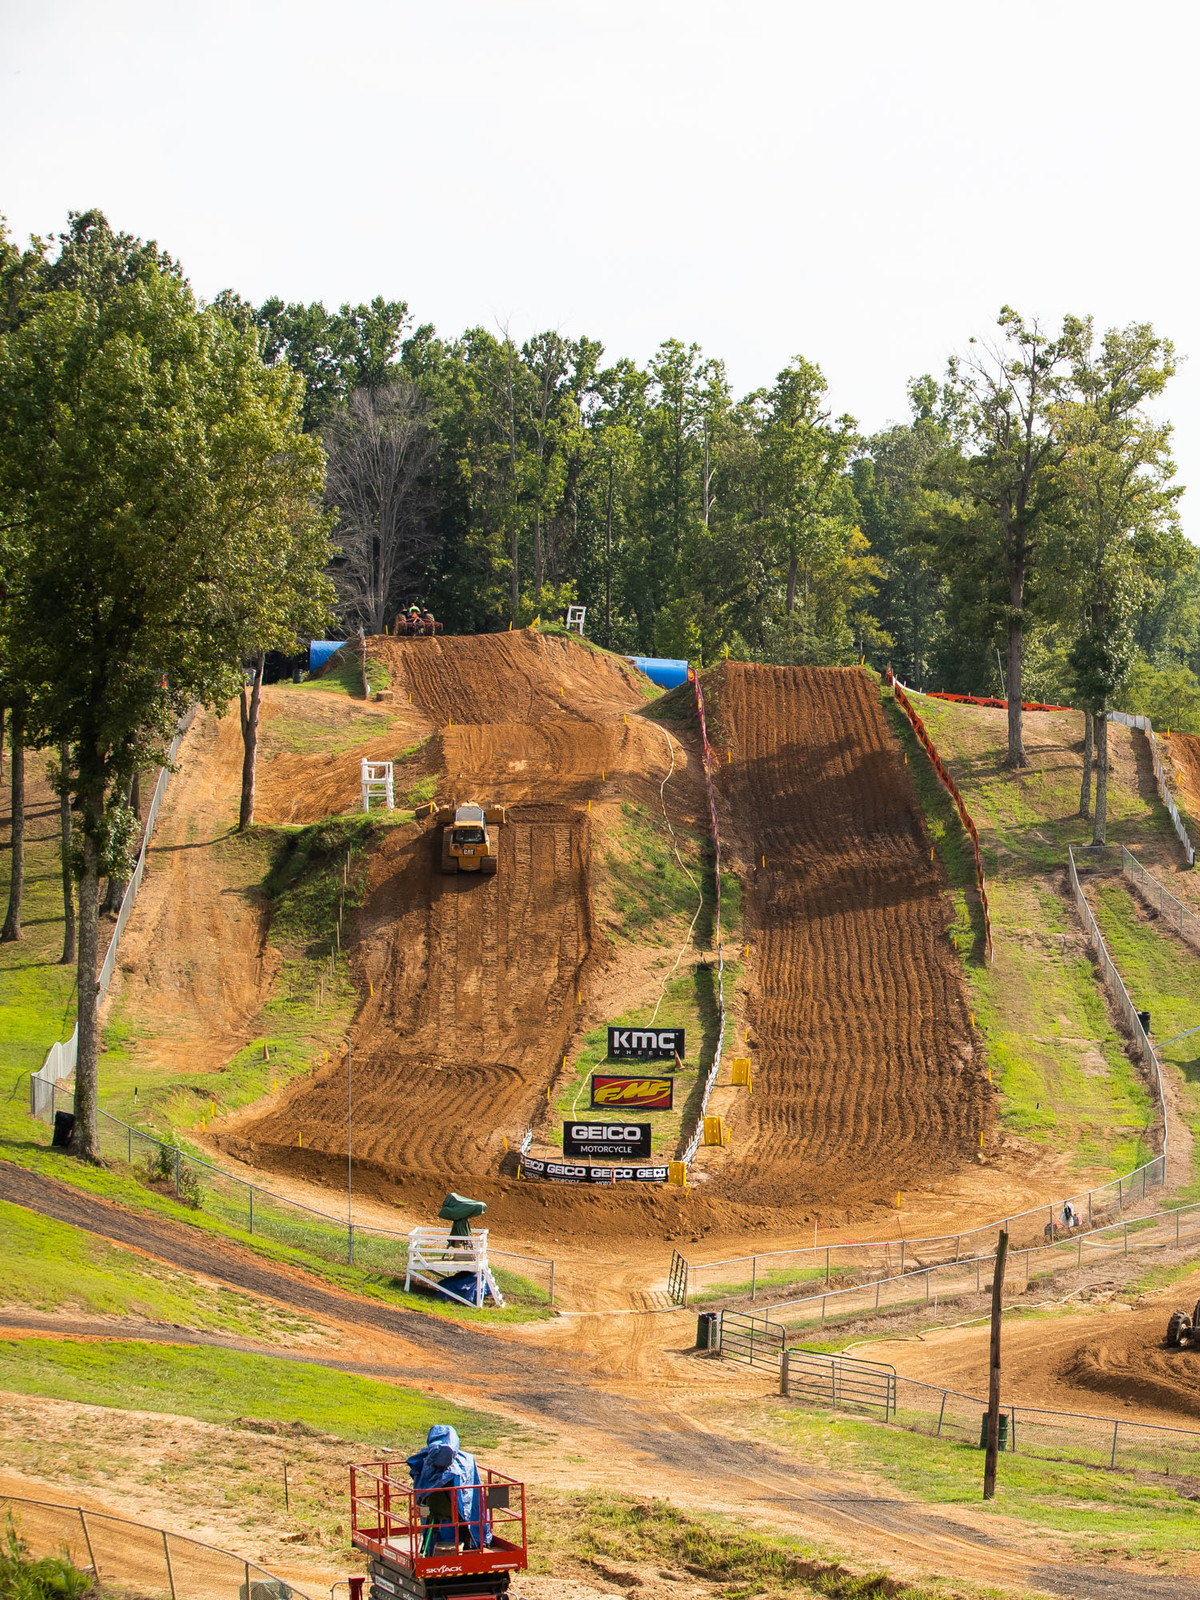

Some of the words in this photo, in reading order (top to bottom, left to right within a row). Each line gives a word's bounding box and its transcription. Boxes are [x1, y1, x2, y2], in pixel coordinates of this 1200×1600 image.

[613, 1031, 675, 1049] KMC
[594, 1080, 671, 1103] FMF
[571, 1126, 642, 1140] GEICO
[525, 1159, 544, 1171] EICO
[547, 1164, 586, 1176] GEICO
[426, 1565, 462, 1574] SKYJACK
